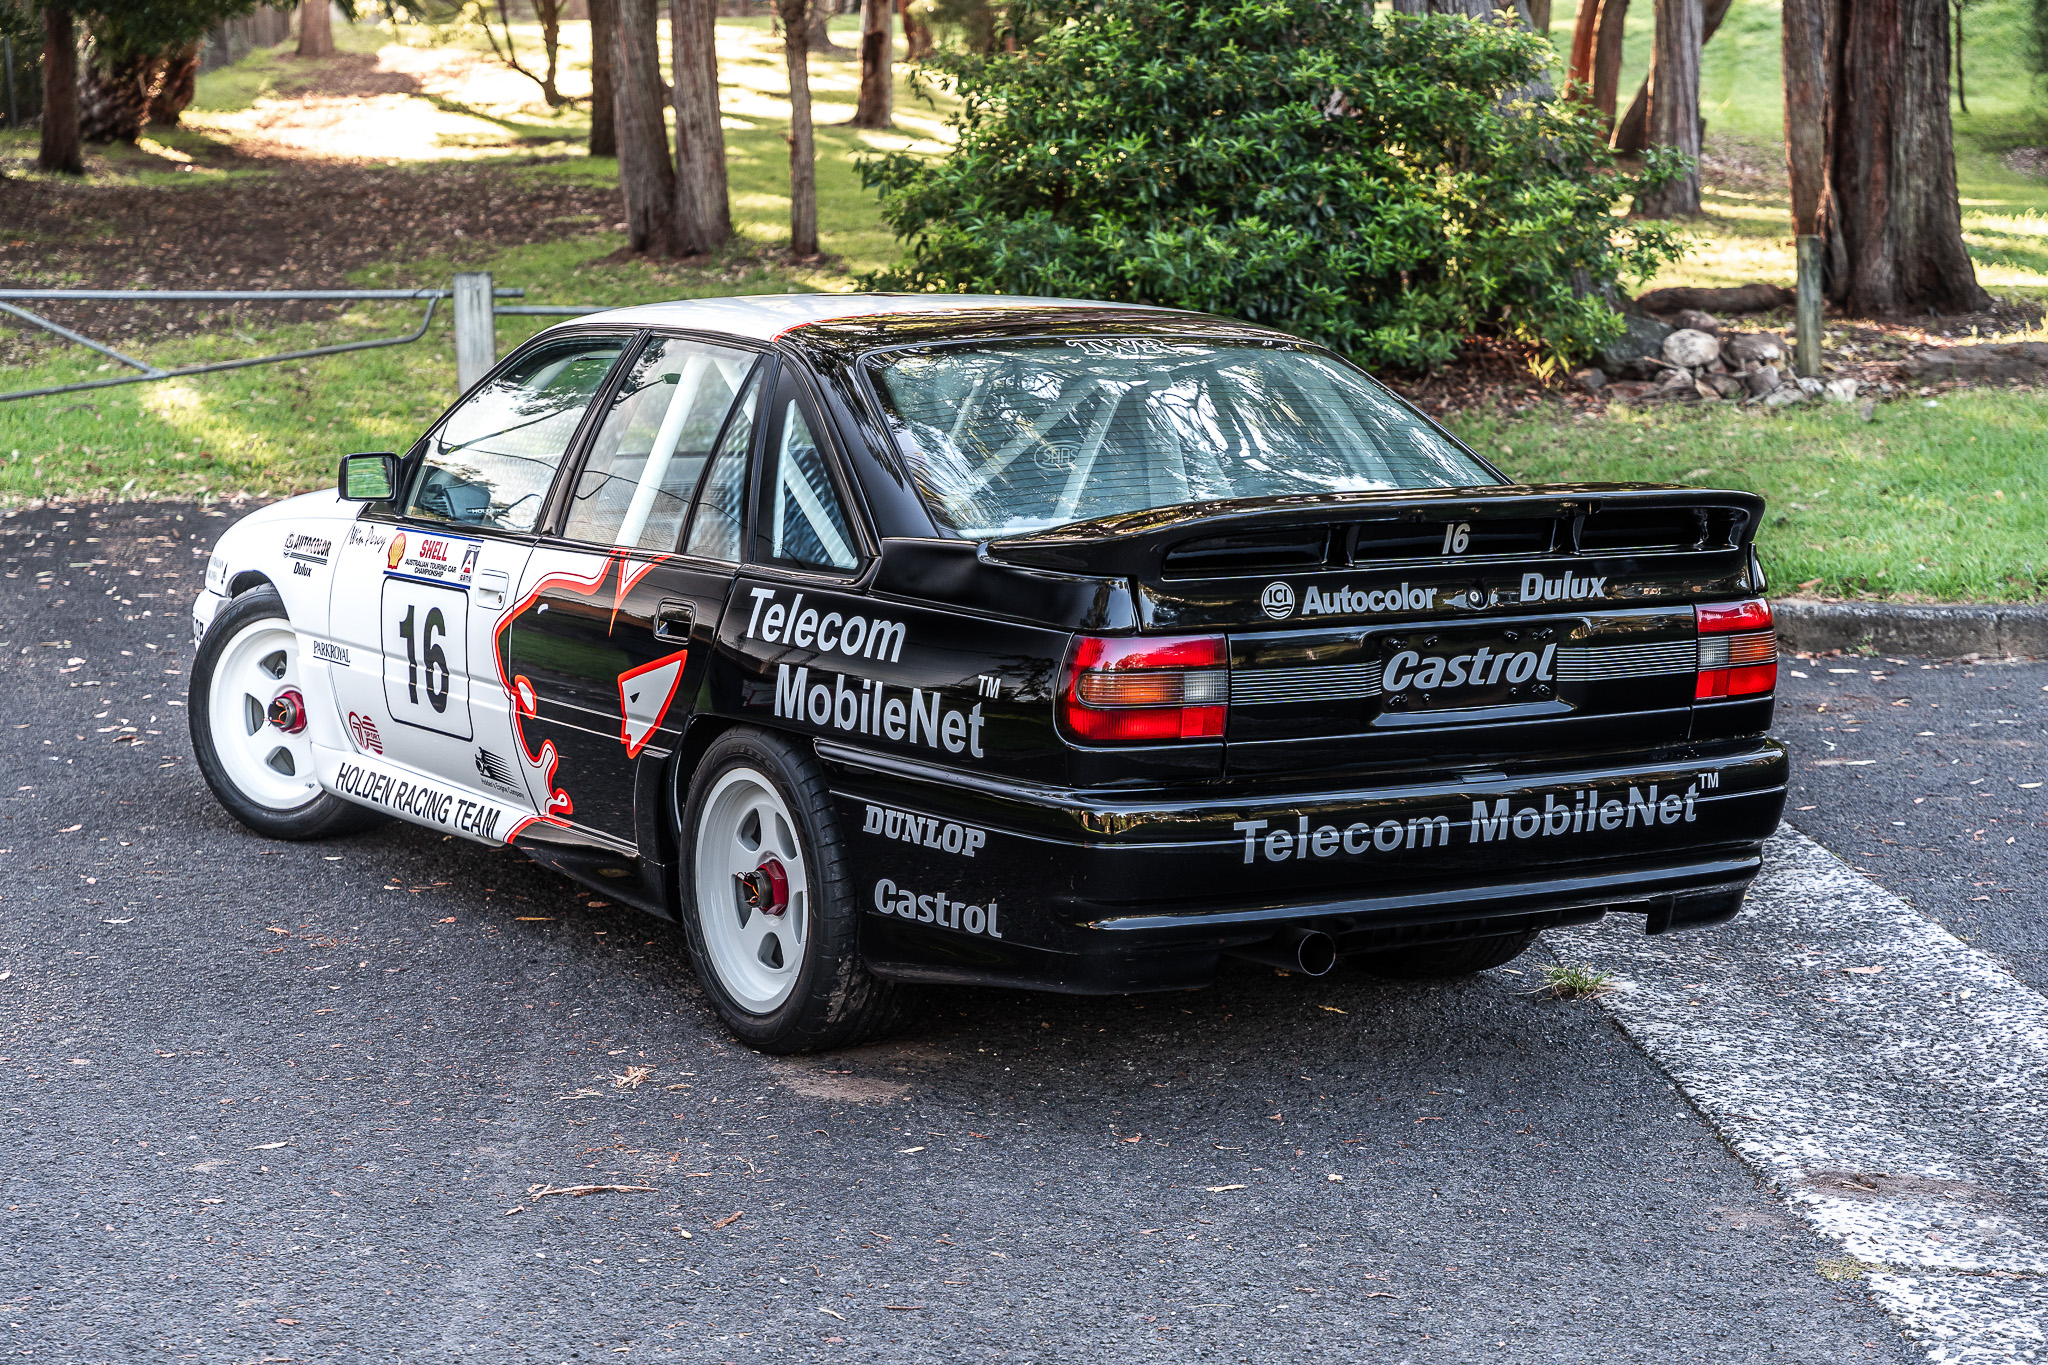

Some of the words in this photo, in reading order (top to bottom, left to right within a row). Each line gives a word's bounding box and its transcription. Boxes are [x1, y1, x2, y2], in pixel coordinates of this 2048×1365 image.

[293, 534, 331, 557] AUTOCOLOR
[419, 539, 449, 561] SHELL
[1442, 523, 1470, 554] 16
[293, 561, 312, 577] Dulux
[405, 558, 429, 569] AUSTRALIAN
[429, 562, 447, 571] TOURING
[447, 565, 457, 573] CAR
[414, 566, 444, 577] CHAMPIONSHIP
[1268, 588, 1288, 604] ICI
[1301, 582, 1437, 615] Autocolor
[1520, 571, 1607, 602] Dulux
[746, 587, 906, 663] Telecom
[313, 640, 350, 663] PARKROYAL
[399, 604, 450, 714] 16
[1382, 642, 1558, 692] Castrol
[774, 664, 985, 758] MobileNet
[978, 675, 1001, 698] TM
[364, 730, 381, 741] SPORT
[335, 762, 396, 802] HOLDEN
[394, 782, 451, 824] RACING
[453, 799, 501, 839] TEAM
[863, 804, 986, 858] DUNLOP
[1234, 815, 1449, 864] Telecom
[1469, 782, 1699, 844] MobileNet
[1698, 772, 1719, 789] TM
[874, 878, 1002, 939] Castrol
